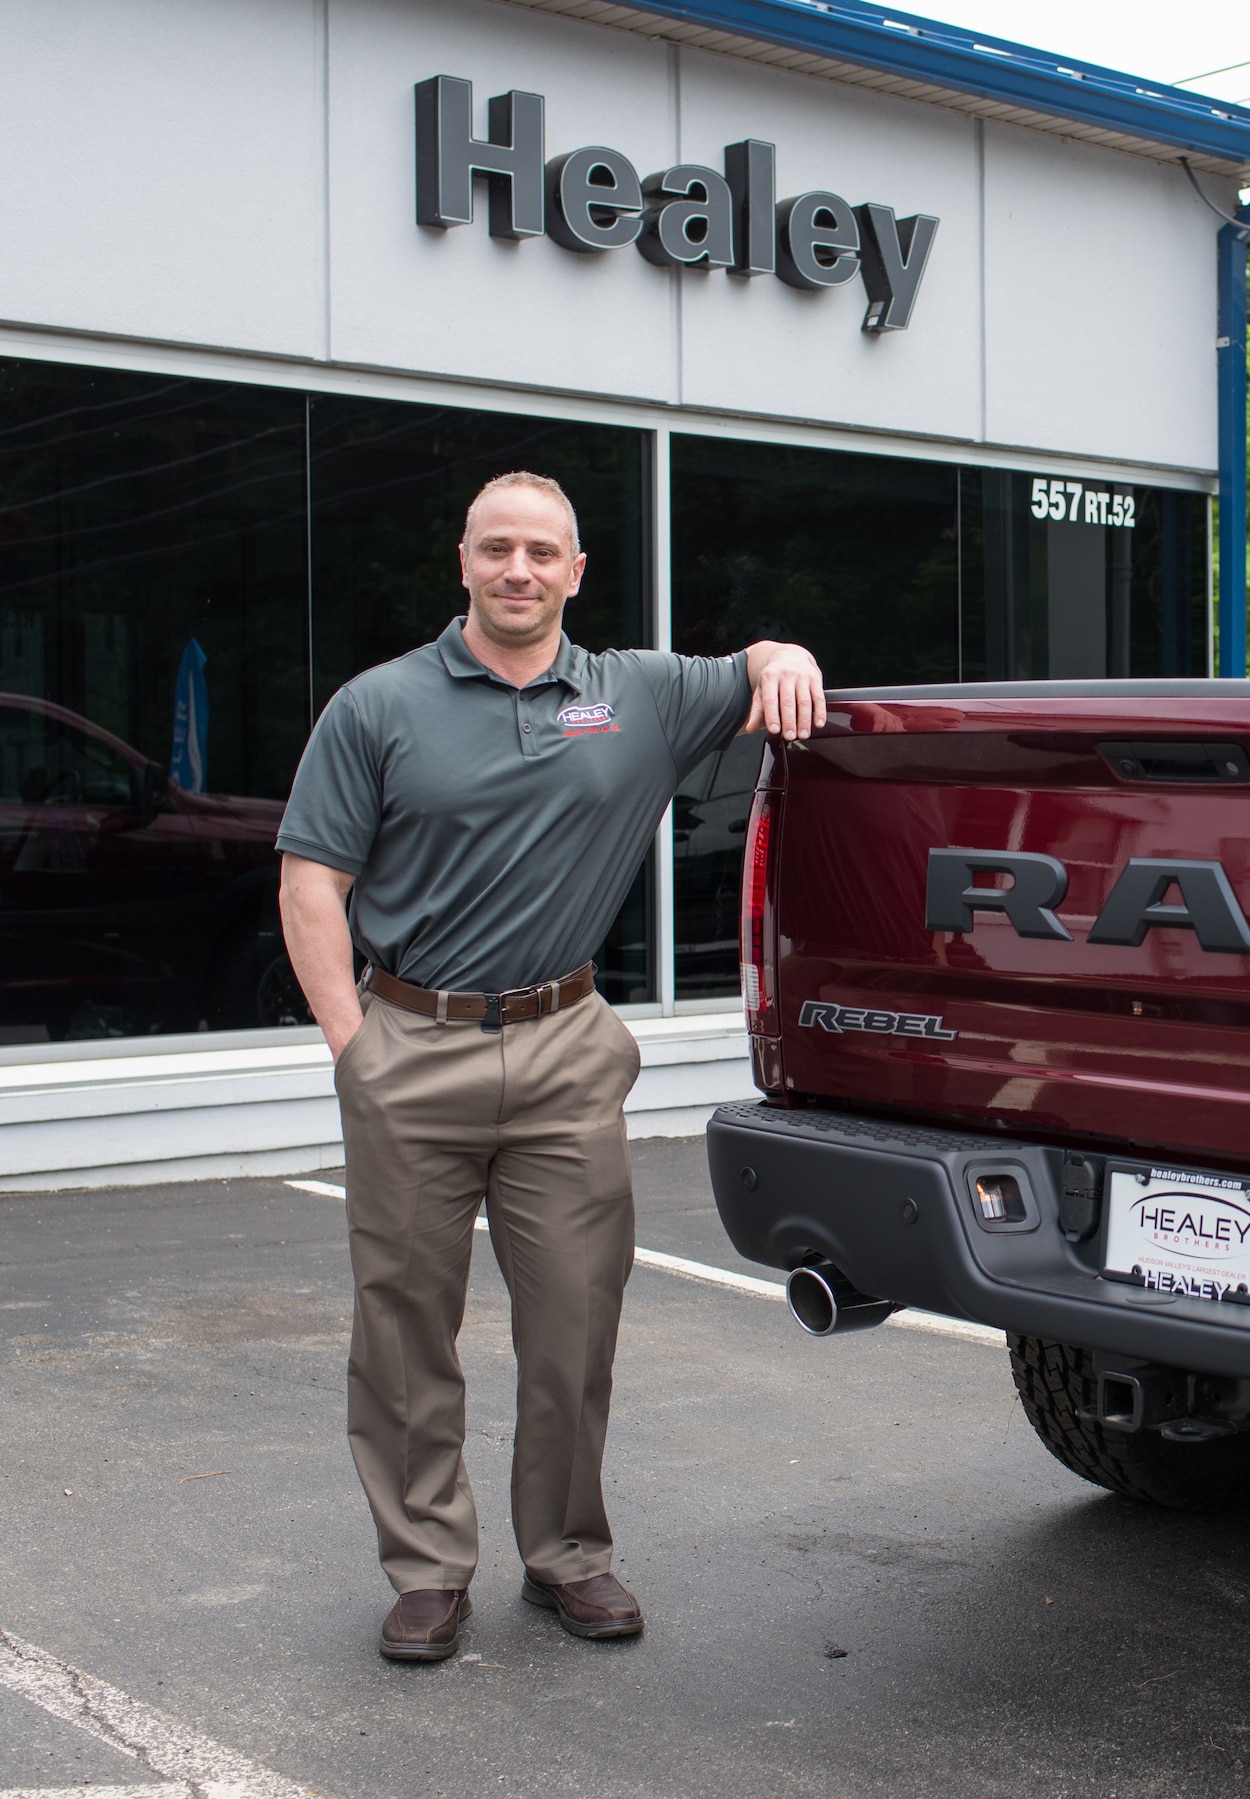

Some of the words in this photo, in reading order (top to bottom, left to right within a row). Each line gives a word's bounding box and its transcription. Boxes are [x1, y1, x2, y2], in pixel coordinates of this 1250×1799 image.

[415, 74, 941, 334] Healey
[1031, 478, 1082, 522] 557
[1084, 490, 1135, 528] RT.52
[562, 707, 609, 723] HEALEY
[1150, 1168, 1243, 1190] healeybrothers.com
[1153, 1232, 1230, 1252] BROTHERS
[1138, 1256, 1164, 1266] HUDSON
[1164, 1260, 1192, 1271] VALLEY'S
[1192, 1265, 1221, 1276] LARGEST
[1221, 1270, 1246, 1281] DEALER
[1144, 1269, 1231, 1301] HEALEY
